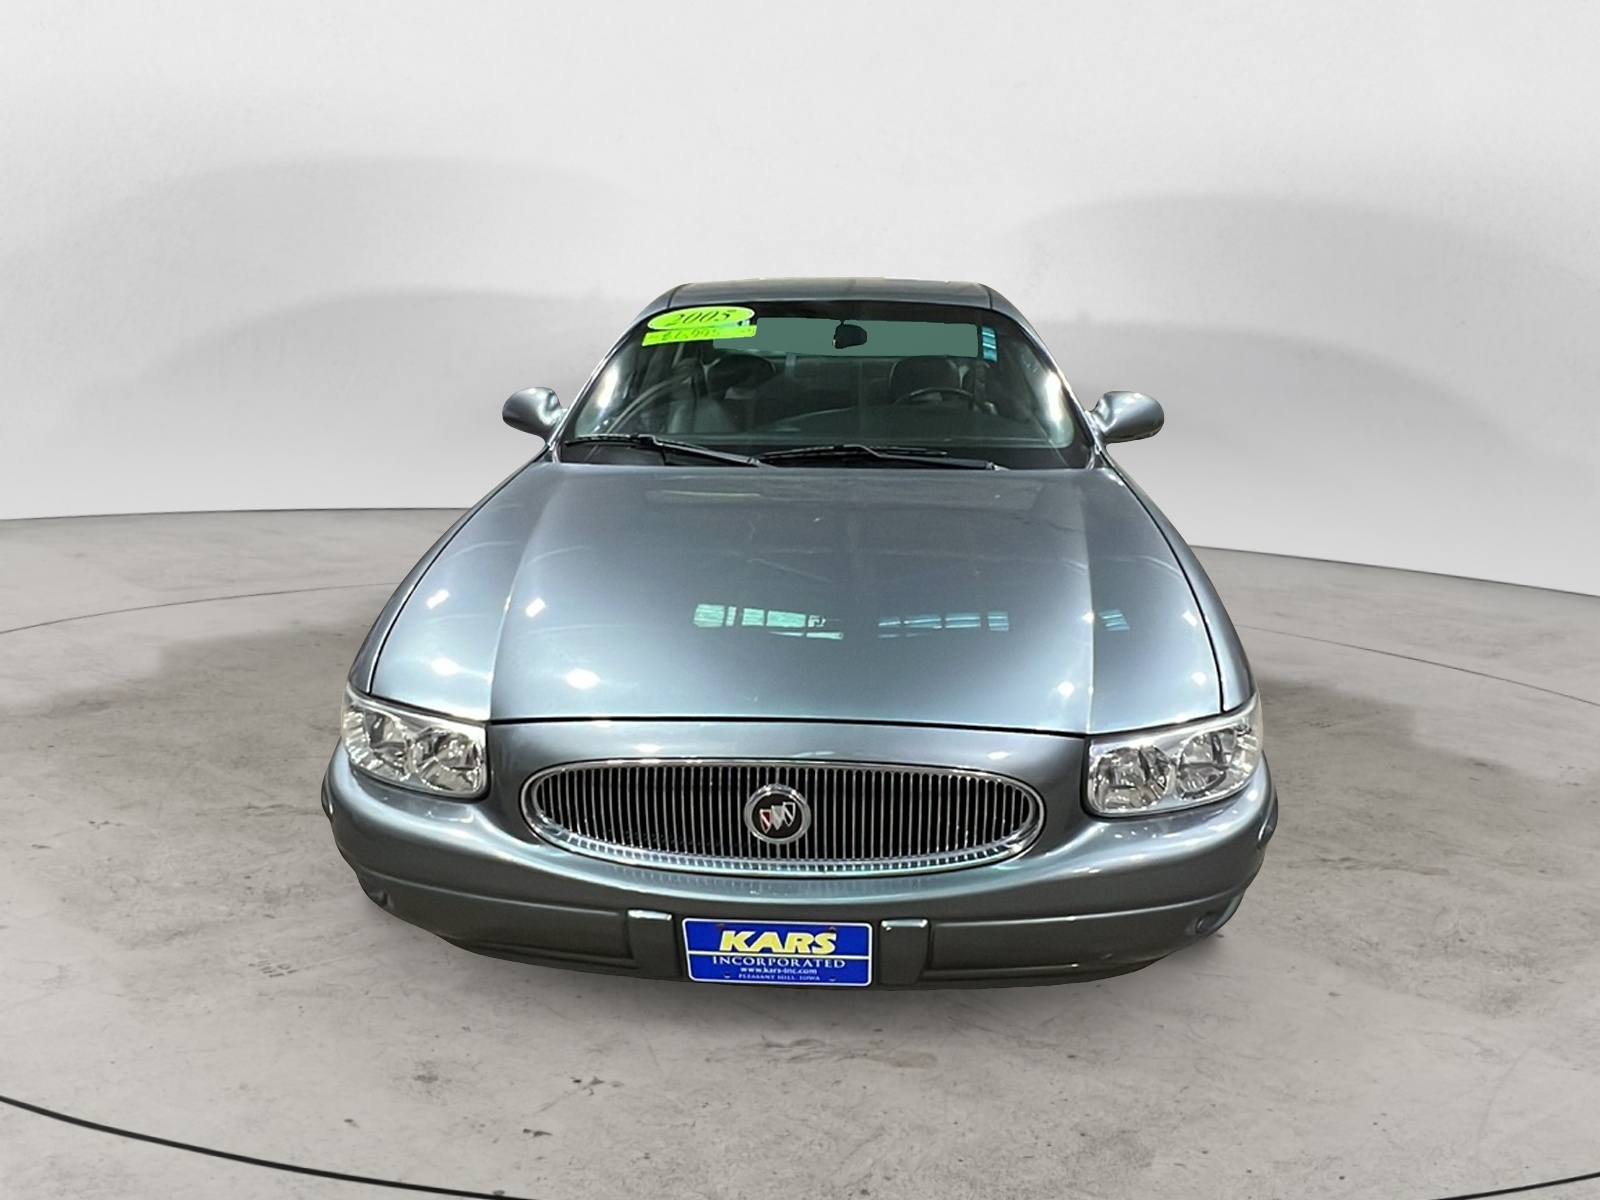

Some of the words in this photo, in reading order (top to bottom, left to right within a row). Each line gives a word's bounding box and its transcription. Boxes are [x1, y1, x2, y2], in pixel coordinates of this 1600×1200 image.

[664, 309, 737, 327] 2005
[719, 930, 837, 954] KARS
[713, 956, 846, 968] INCORPORATED
